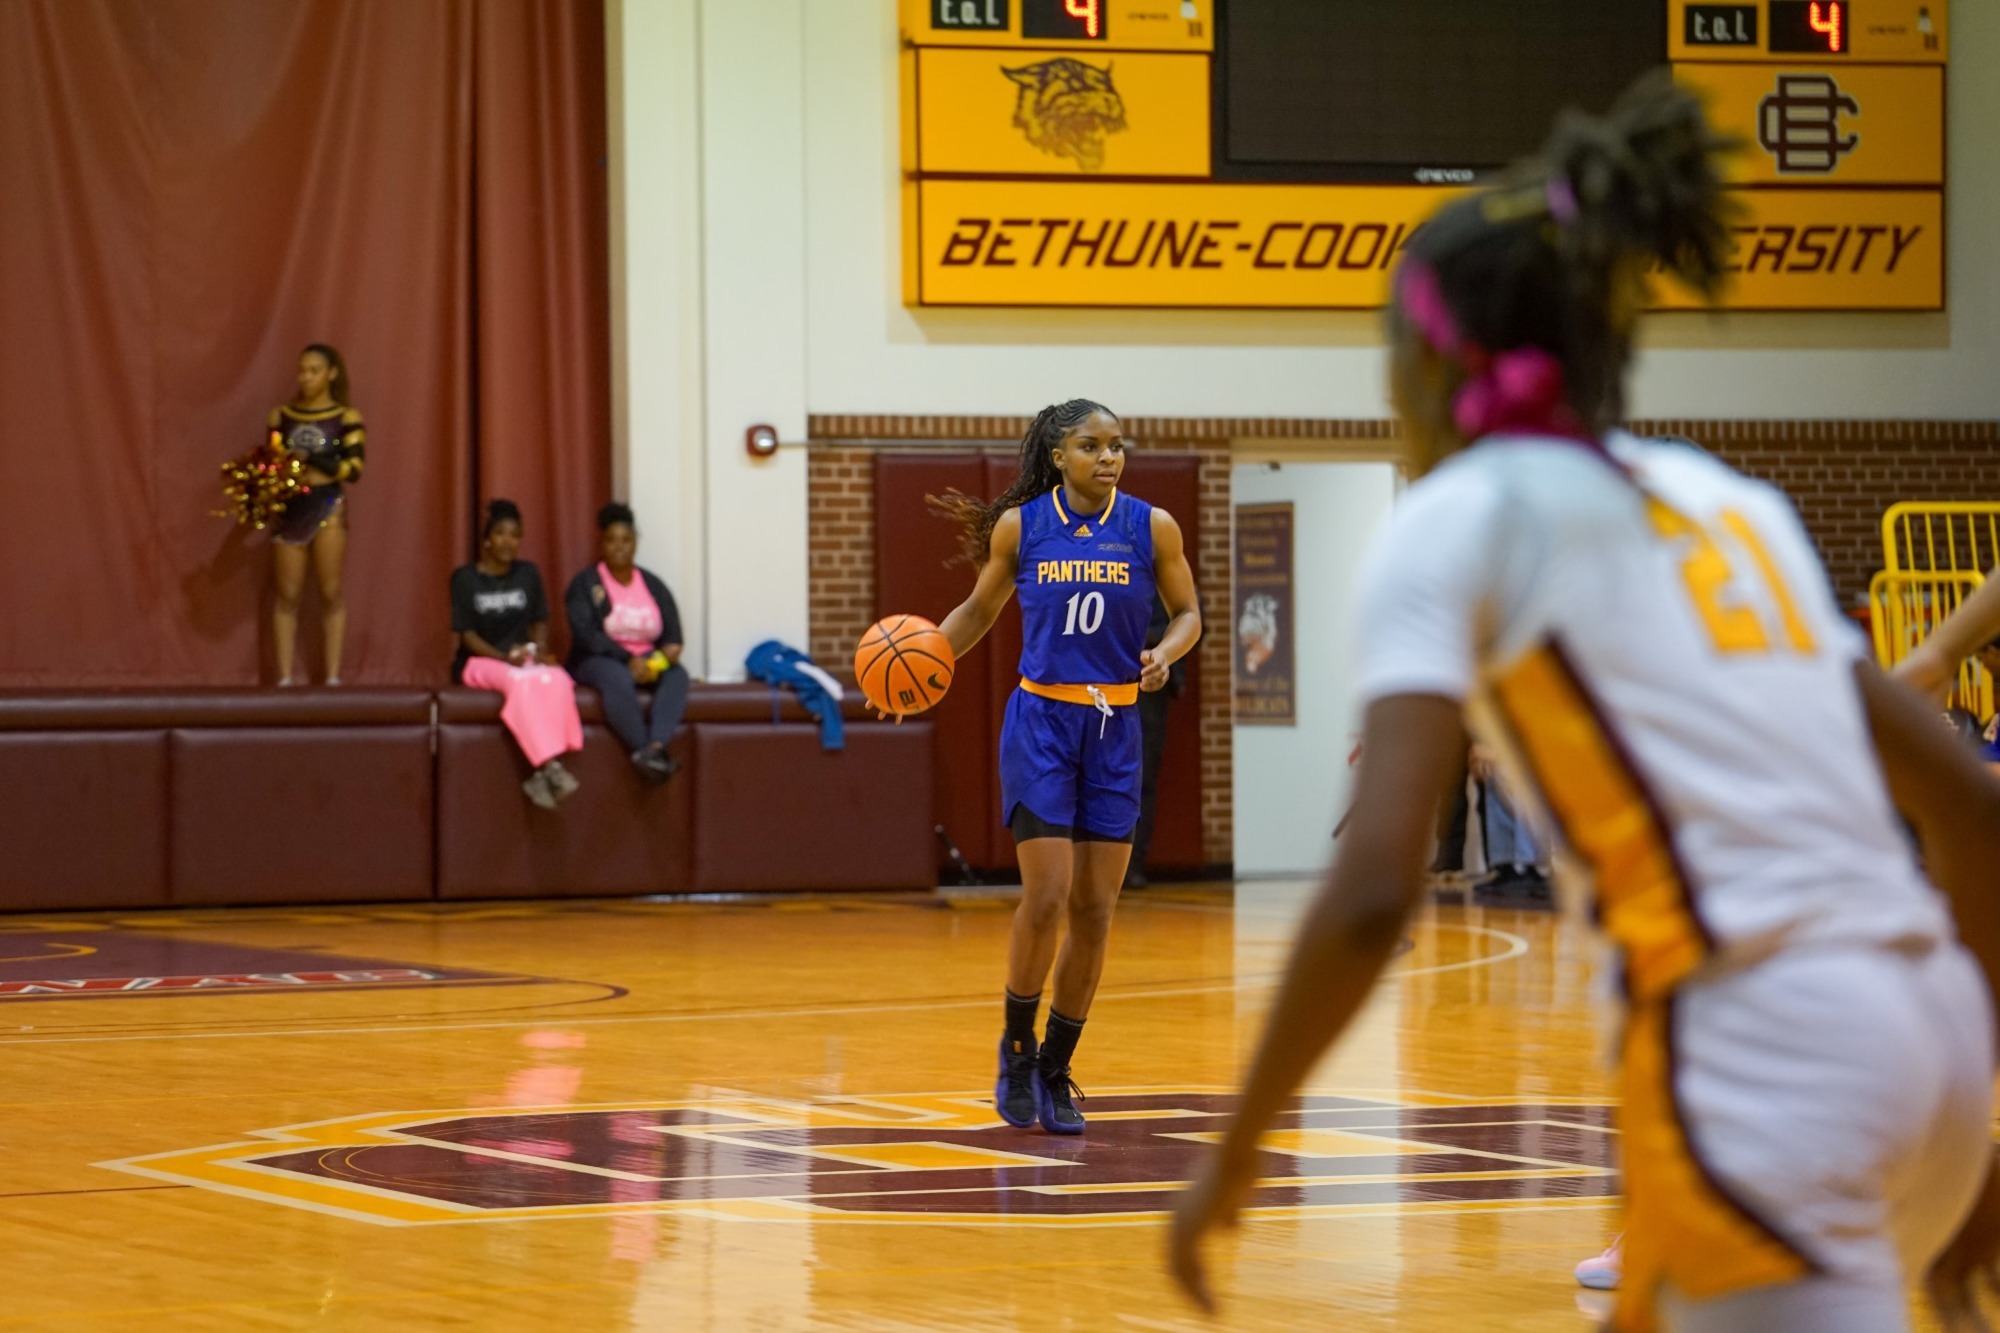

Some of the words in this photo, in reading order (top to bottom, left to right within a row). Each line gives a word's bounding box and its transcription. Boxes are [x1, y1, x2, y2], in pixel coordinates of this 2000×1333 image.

[1064, 0, 1098, 37] 4
[1809, 1, 1840, 52] 4
[1037, 560, 1130, 586] PANTHERS
[1646, 490, 1818, 655] 21
[1062, 591, 1105, 635] 10
